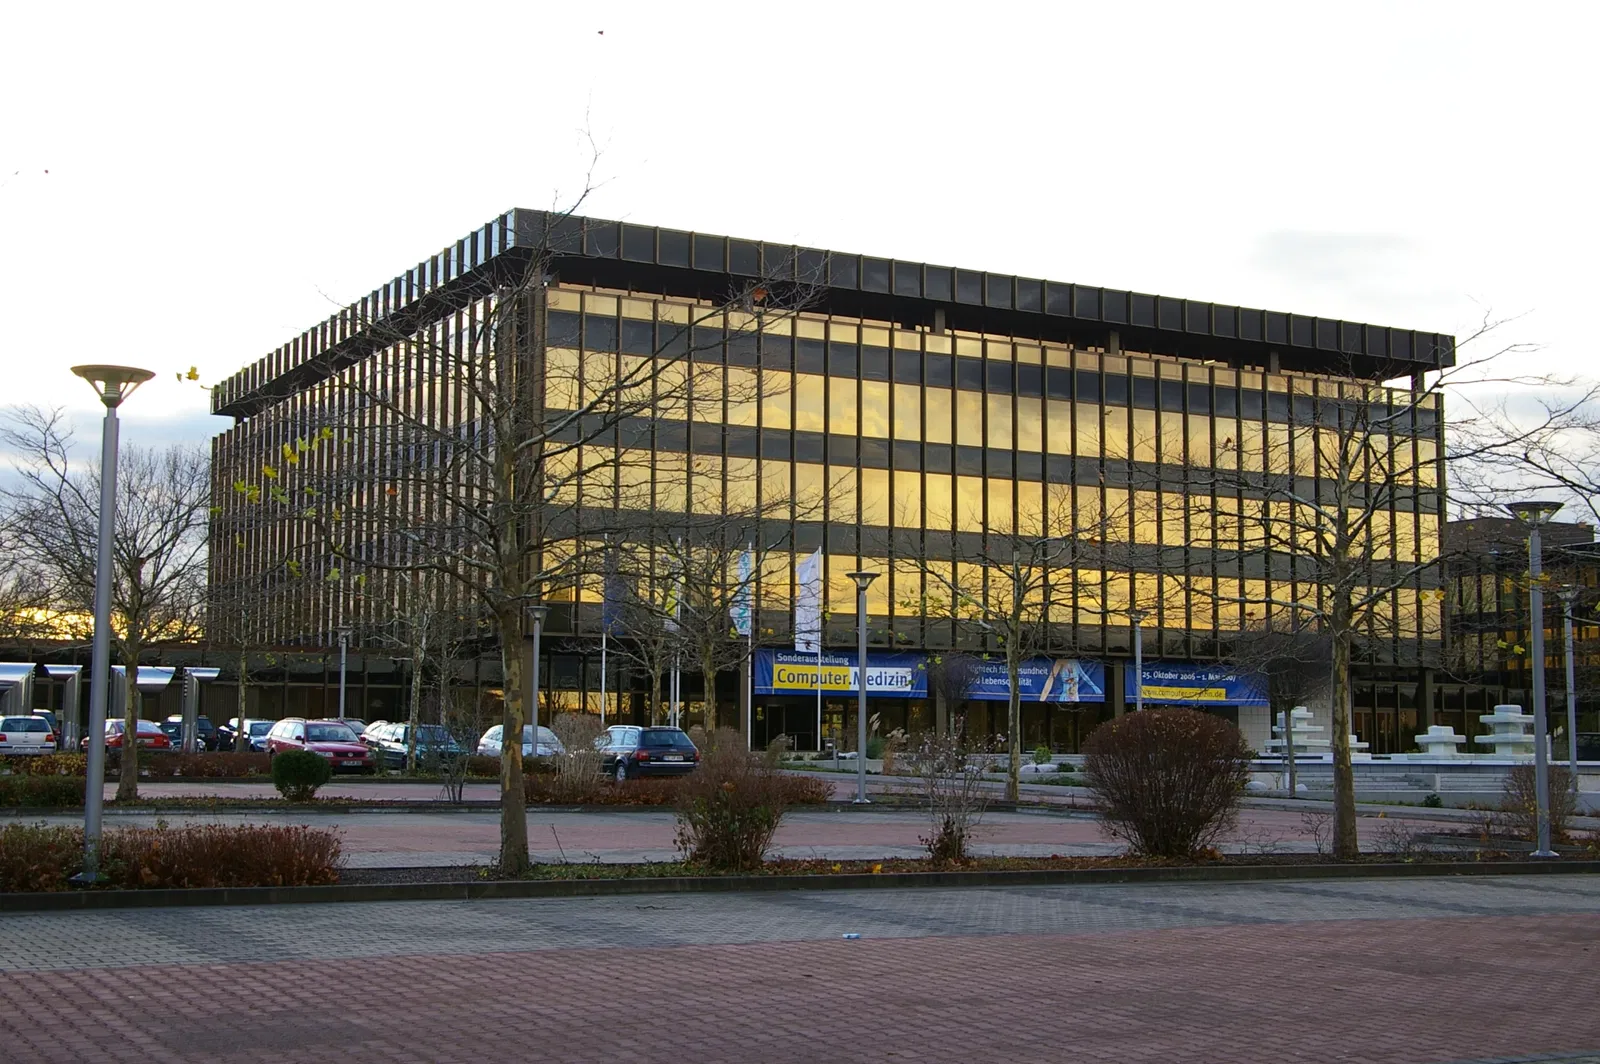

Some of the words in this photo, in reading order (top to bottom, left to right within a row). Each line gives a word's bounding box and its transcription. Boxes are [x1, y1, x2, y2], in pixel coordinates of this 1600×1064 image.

[777, 653, 849, 665] Sonderaustellung
[1142, 672, 1152, 680] 25.
[1153, 671, 1179, 680] Oktober
[1180, 673, 1196, 681] 2006
[982, 677, 1032, 687] Lebensqlität
